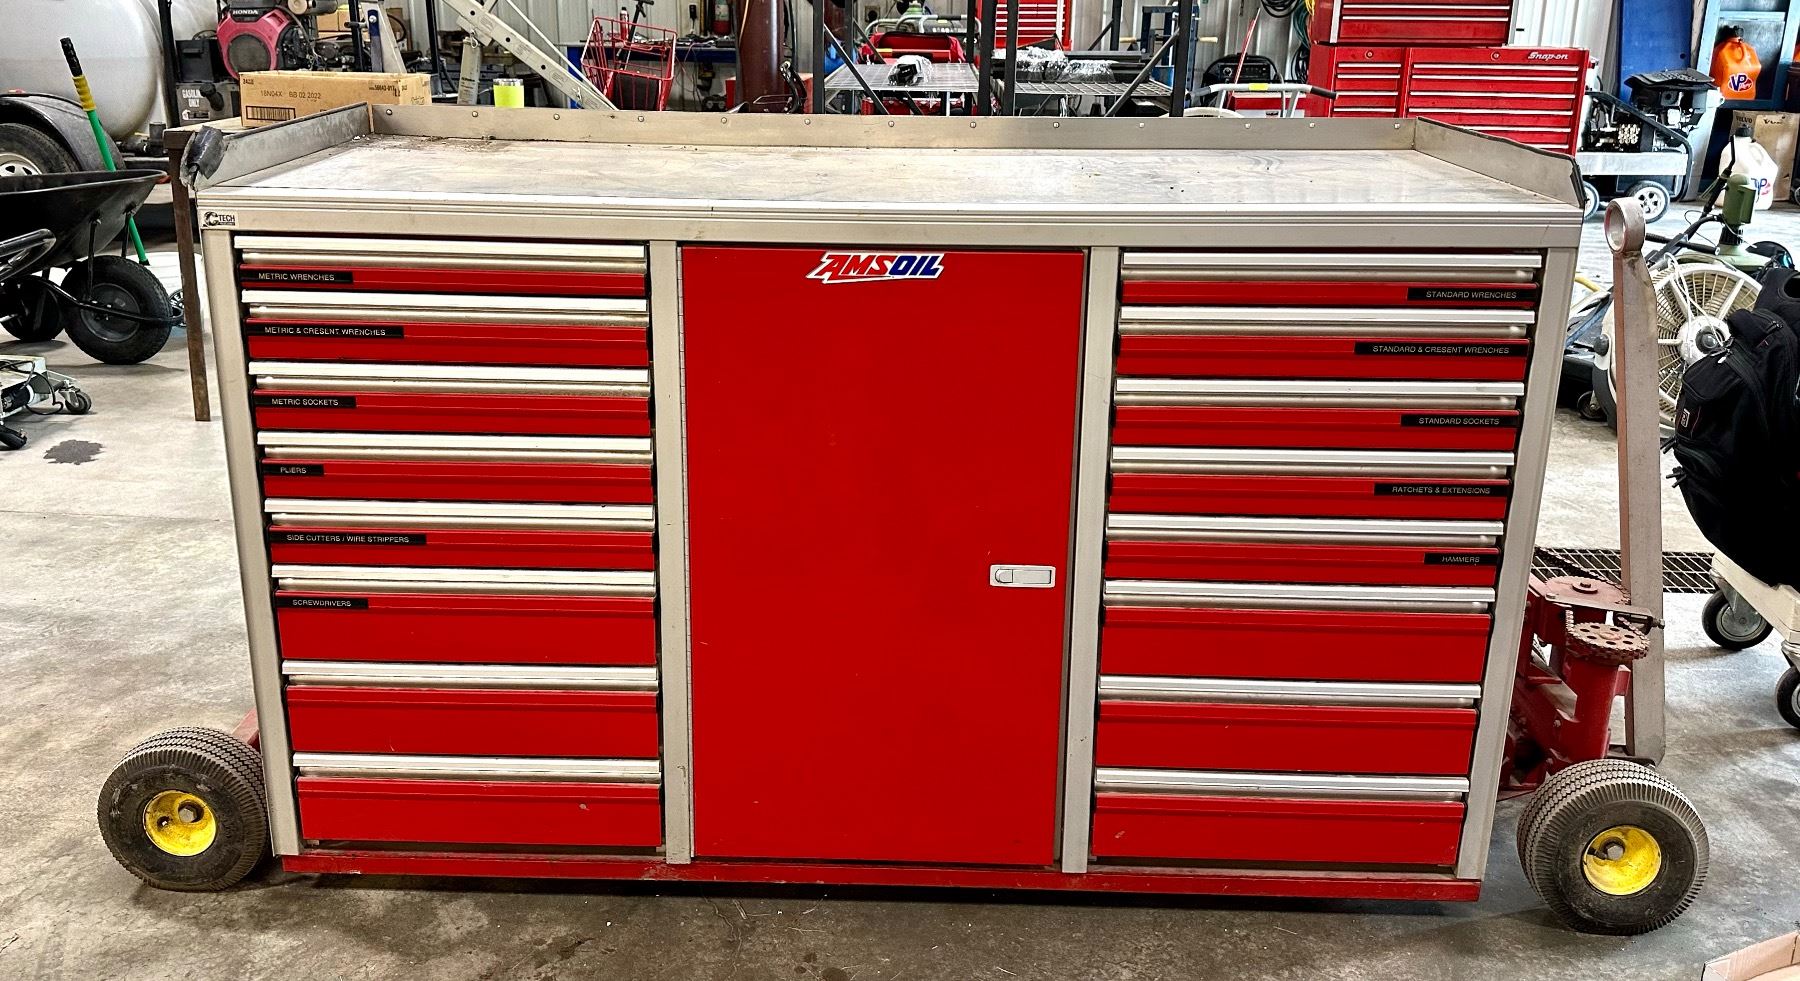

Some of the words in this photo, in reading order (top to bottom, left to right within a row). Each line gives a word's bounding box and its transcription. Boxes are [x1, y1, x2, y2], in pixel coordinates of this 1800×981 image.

[1528, 51, 1568, 61] Snap-on
[299, 91, 306, 99] 02
[189, 99, 200, 108] ONLY
[806, 252, 944, 284] AMSOIL
[258, 272, 289, 280] METRIC
[289, 273, 335, 281] WRENCHES
[1426, 290, 1470, 298] STANDARD
[1471, 291, 1517, 299] WRENCHES
[264, 326, 294, 334] METRIC
[303, 327, 340, 335] CRESENT
[341, 328, 386, 336] WRENCHES
[1372, 345, 1416, 353] STANDARD
[1424, 345, 1463, 354] CRESENT
[1464, 346, 1510, 354] WRENCHES
[302, 398, 339, 406] SOCKETS
[1418, 417, 1462, 425] STANDARD
[1462, 417, 1500, 425] SOCKETS
[280, 466, 307, 474] PLIERS
[1441, 486, 1491, 494] EXTENSIONS
[305, 534, 341, 542] CUTTERS
[367, 535, 410, 543] STRIPPERS
[292, 599, 352, 607] SCREWDRIVERS
